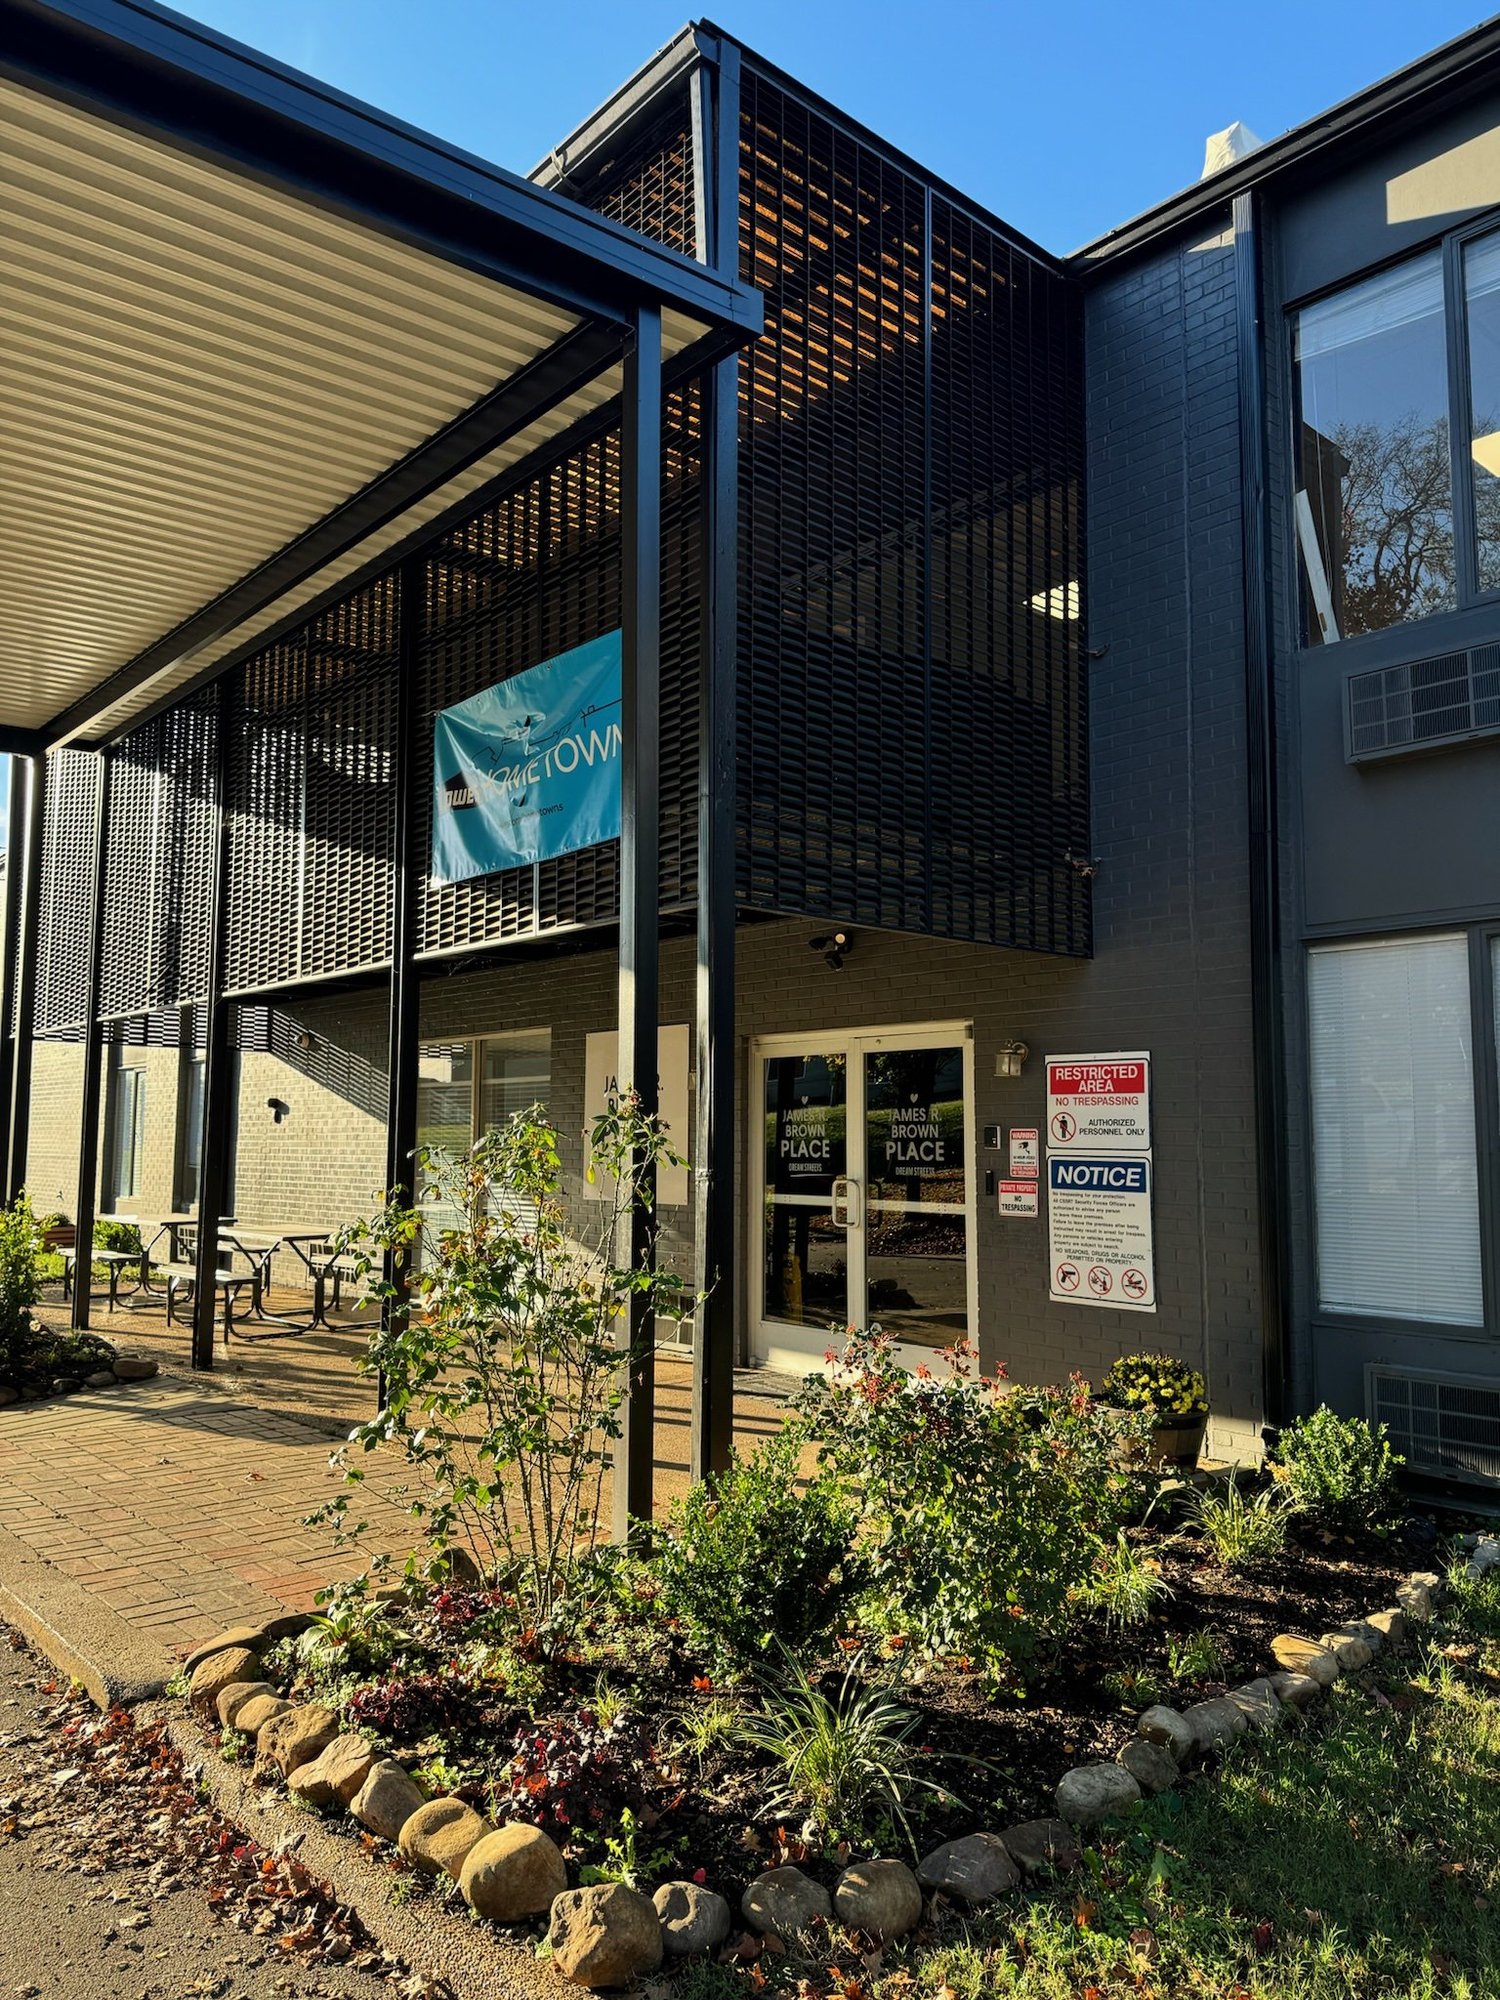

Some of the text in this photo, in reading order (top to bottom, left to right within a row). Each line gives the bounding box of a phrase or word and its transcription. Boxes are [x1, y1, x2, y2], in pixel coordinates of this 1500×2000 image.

[1055, 1065, 1139, 1080] RESTRICTED
[1078, 1080, 1114, 1093] AREA
[1055, 1096, 1139, 1107] NO TRESPASSING
[782, 1109, 829, 1122] JAMES R.
[888, 1108, 942, 1122] JAMES R.
[1088, 1119, 1136, 1127] AUTHORIZED
[785, 1124, 825, 1137] BROWN
[891, 1124, 939, 1138] BROWN
[1079, 1128, 1145, 1136] PERSONNEL ONLY
[780, 1140, 830, 1158] PLACE
[885, 1141, 945, 1161] PLACE
[1057, 1165, 1142, 1187] NOTICE
[1001, 1203, 1036, 1213] TRESPASSING
[1091, 1250, 1110, 1258] DRUGS
[1120, 1253, 1146, 1261] ALCOHOL
